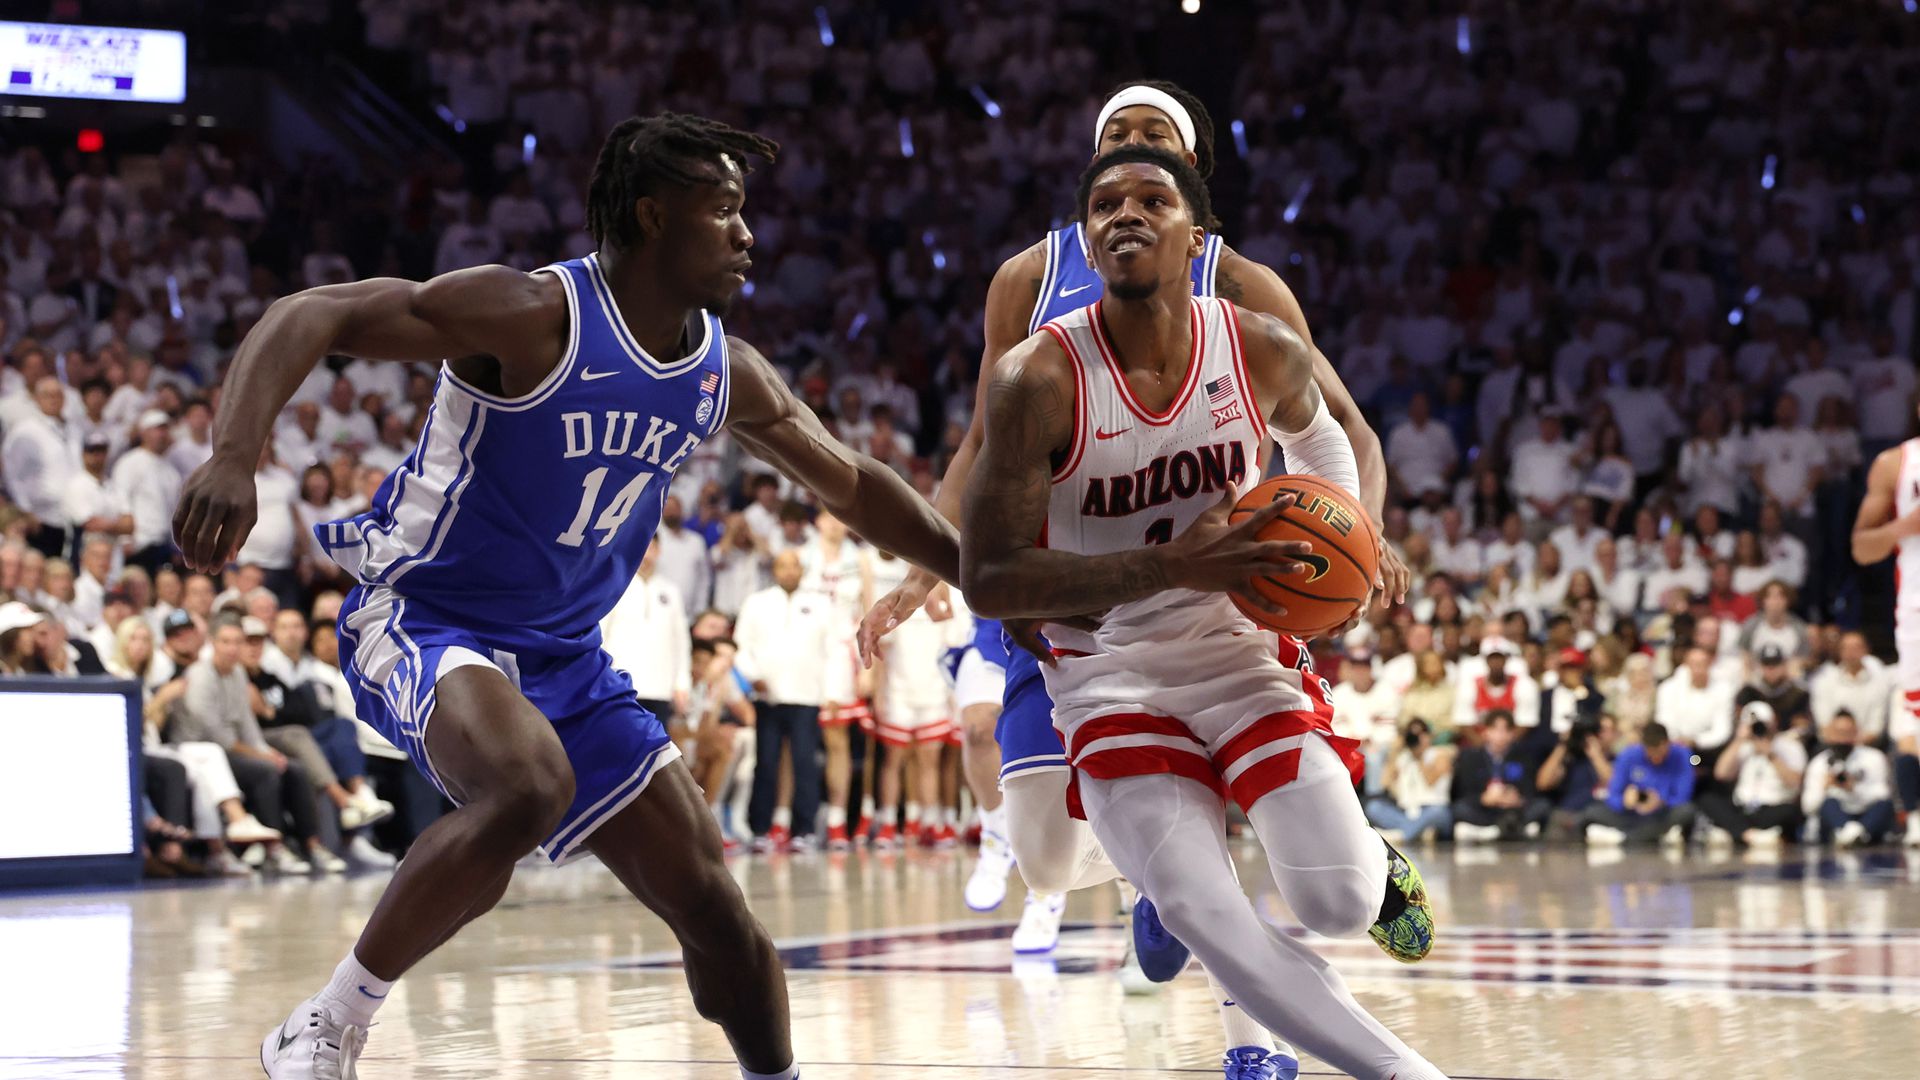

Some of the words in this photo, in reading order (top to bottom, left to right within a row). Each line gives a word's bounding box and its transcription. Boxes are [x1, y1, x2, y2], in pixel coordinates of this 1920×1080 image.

[561, 411, 701, 474] DUKE
[1081, 440, 1247, 517] ARIZONA
[556, 467, 654, 547] 14
